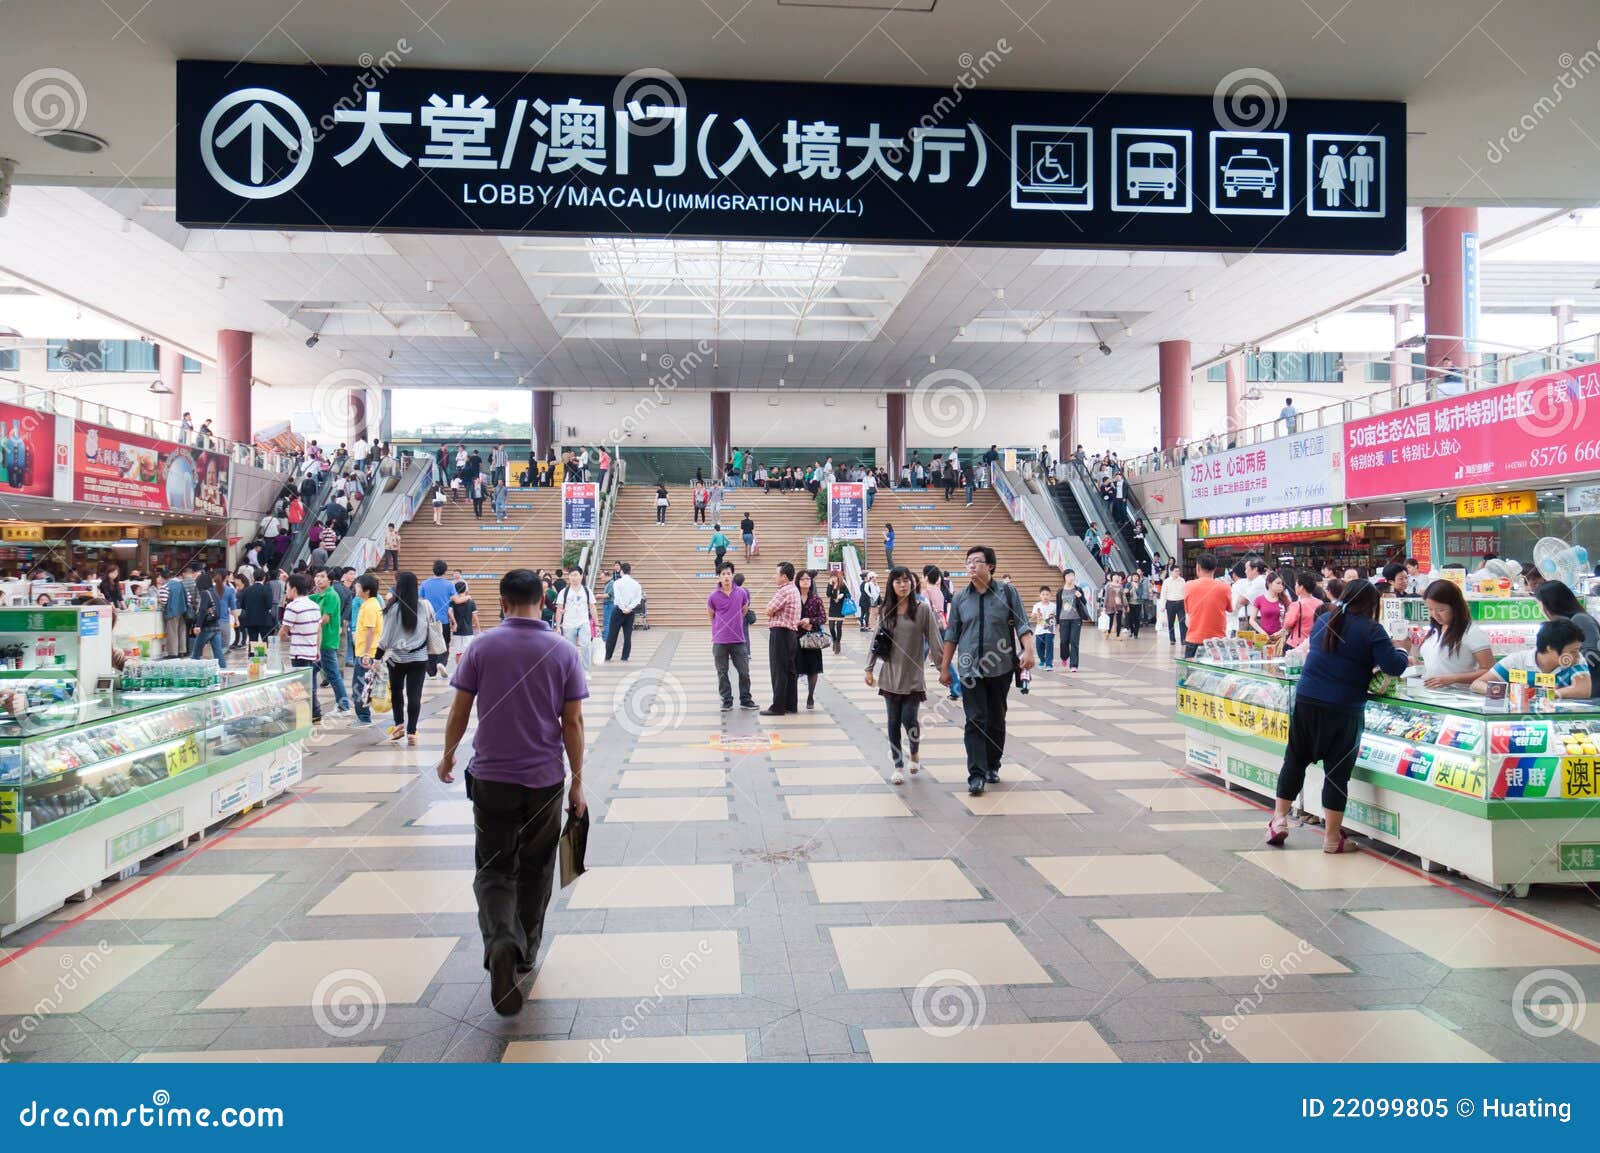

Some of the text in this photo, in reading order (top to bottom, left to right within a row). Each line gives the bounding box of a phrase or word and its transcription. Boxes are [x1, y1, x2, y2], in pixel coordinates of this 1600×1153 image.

[1349, 390, 1535, 448] 50亩生态公园 城市特别住区
[1190, 449, 1267, 483] 2万入住 心动两房
[1530, 444, 1568, 468] 8576
[1505, 767, 1546, 787] 银联
[1567, 759, 1600, 796] 澳
